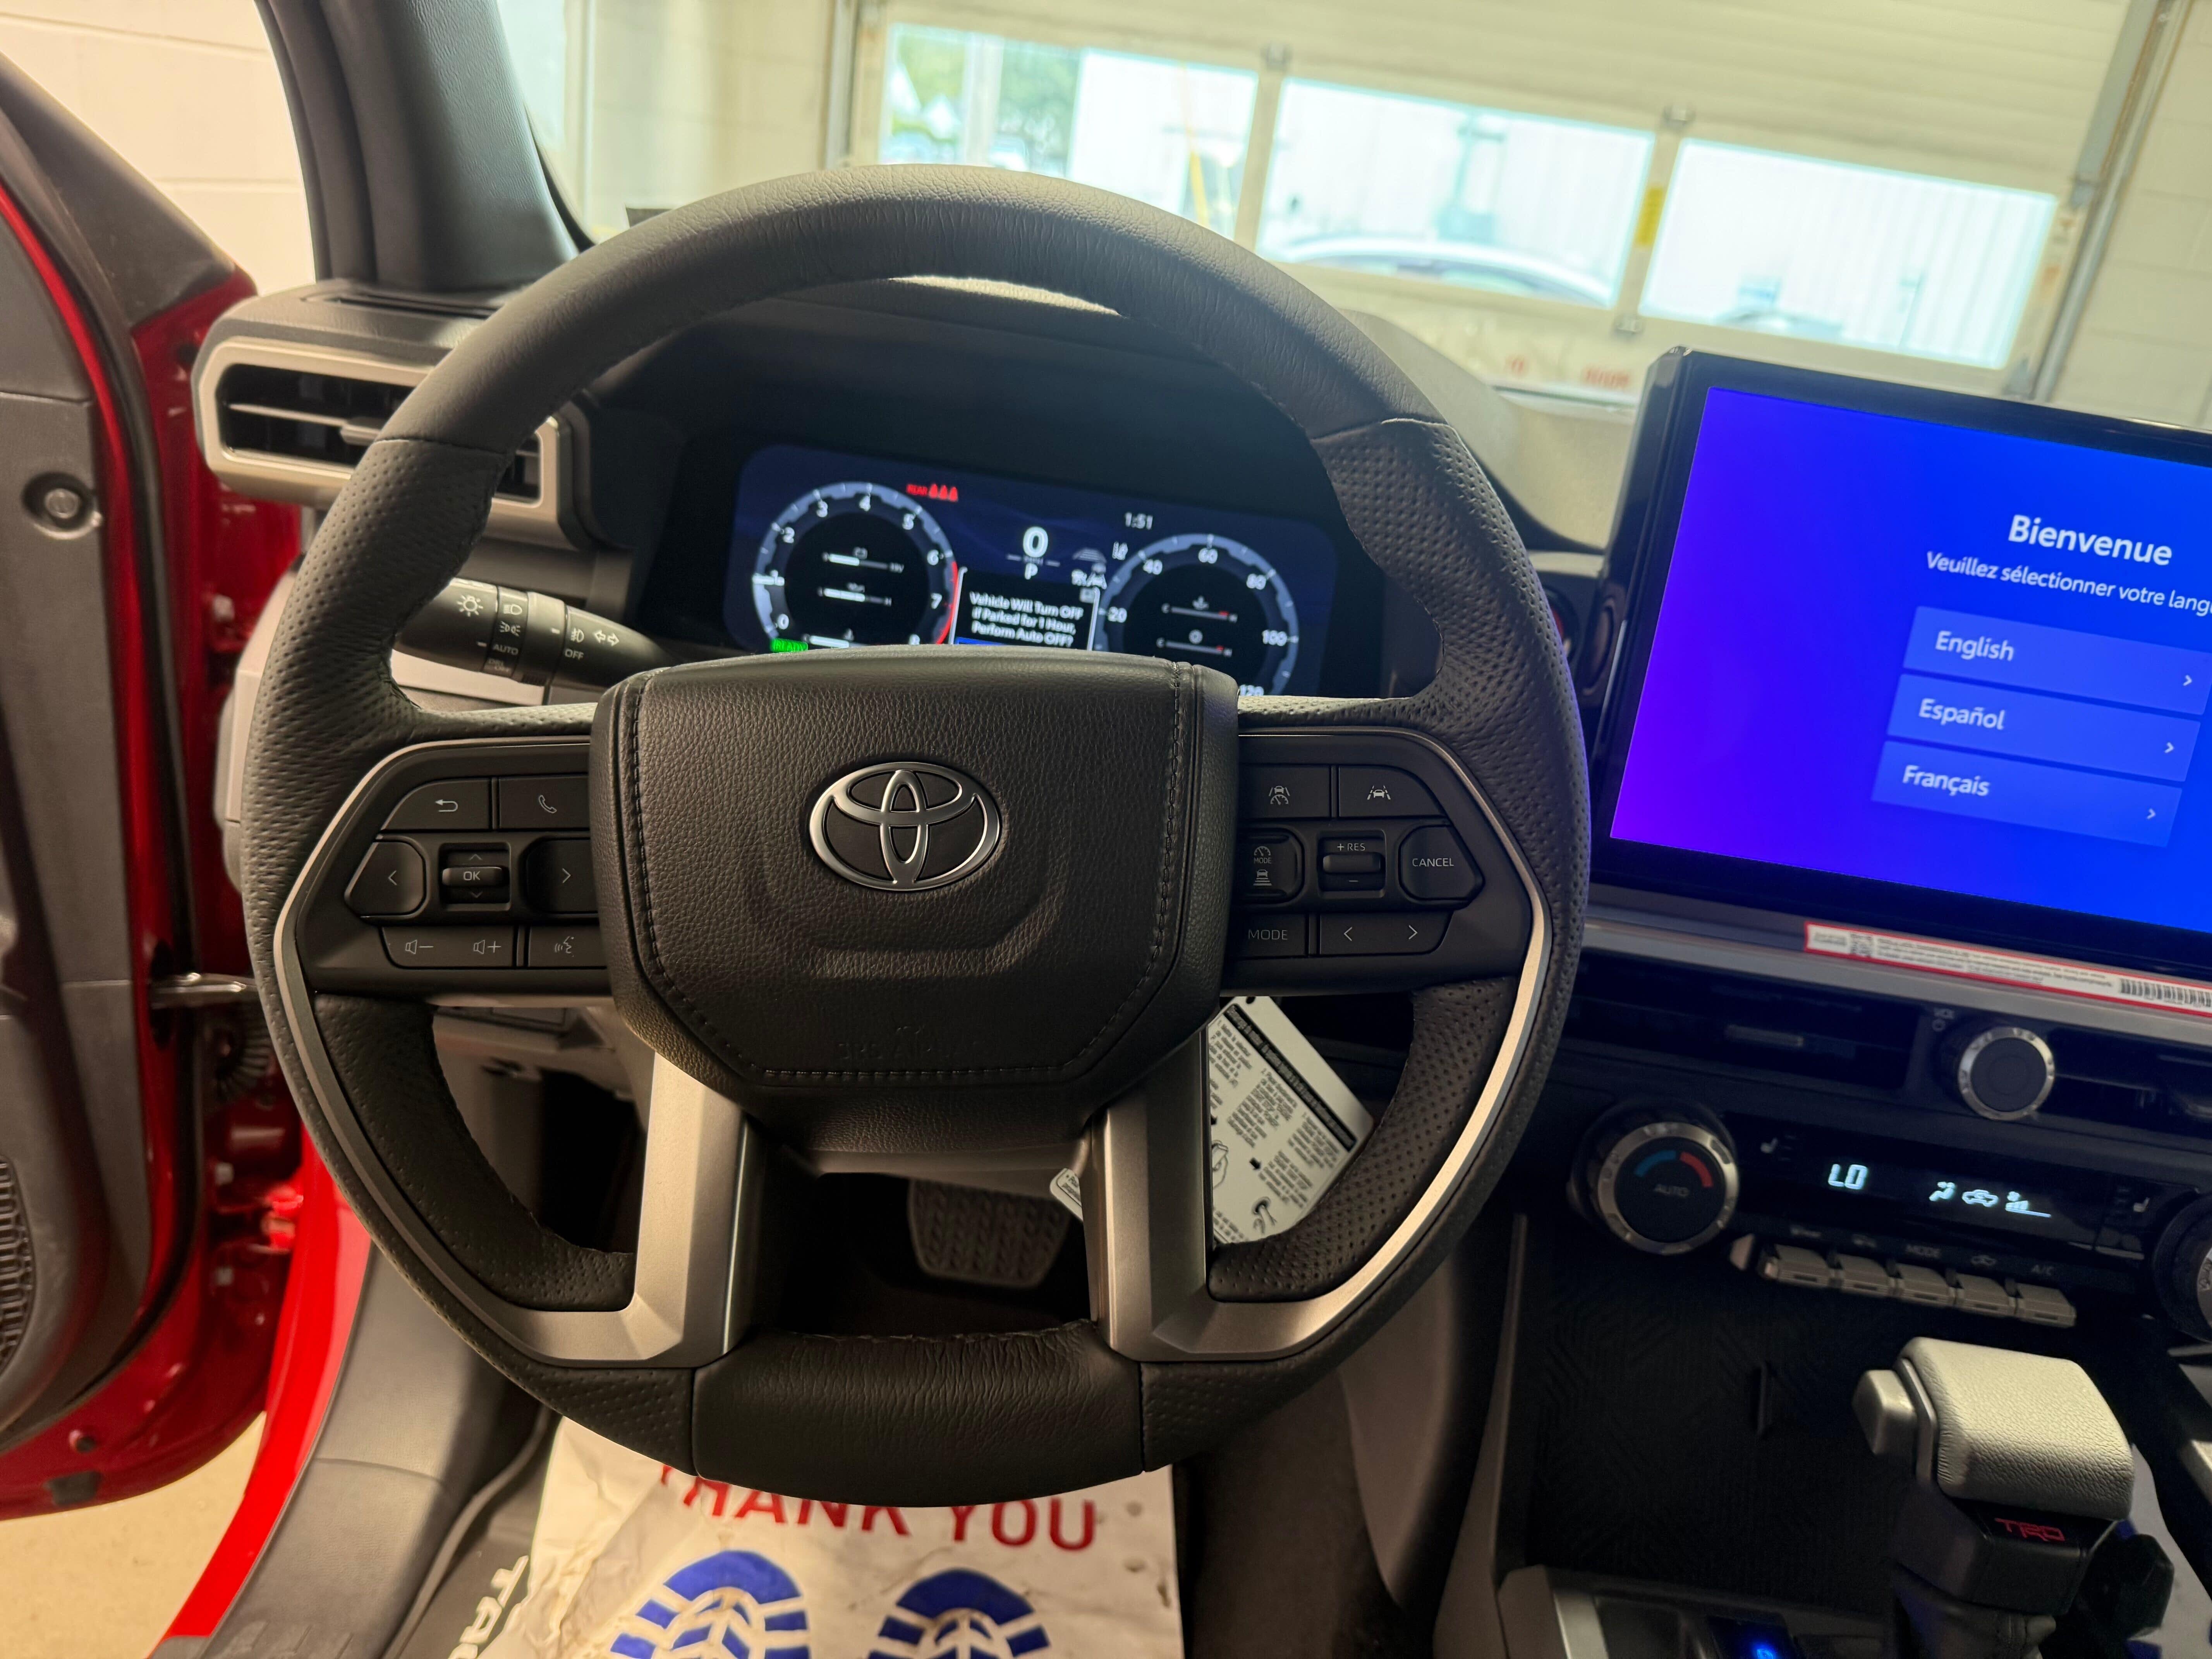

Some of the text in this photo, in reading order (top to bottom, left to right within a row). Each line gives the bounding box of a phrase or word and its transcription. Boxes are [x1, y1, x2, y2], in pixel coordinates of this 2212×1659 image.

[817, 501, 828, 517] 3
[859, 496, 871, 511] 4
[902, 514, 915, 530] 5
[1125, 512, 1153, 530] 1:51
[783, 527, 795, 543] 2
[1023, 526, 1048, 557] 0
[2008, 514, 2172, 566] Bienvenue
[927, 550, 939, 565] 6
[1198, 548, 1218, 564] 60
[1025, 563, 1038, 579] P
[1143, 559, 1163, 575] 40
[1247, 574, 1266, 590] 80
[1927, 551, 1998, 579] Veuillez
[2000, 565, 2116, 598] sélectionner
[2119, 587, 2165, 606] votre
[931, 593, 942, 609] 7
[969, 591, 1010, 609] Vehicle
[1010, 598, 1033, 613] Will
[1034, 601, 1059, 617] Turn
[777, 613, 789, 630] 0
[972, 606, 982, 620] If
[981, 608, 1020, 625] Parked
[1020, 613, 1037, 628] for
[1108, 606, 1127, 623] 20
[971, 620, 1015, 639] Perform
[1015, 628, 1043, 643] Auto
[1262, 629, 1287, 646] 100
[493, 644, 519, 655] AUTO
[1936, 630, 2014, 661] English
[565, 648, 584, 660] OFF
[1918, 698, 2005, 730] Español
[1902, 764, 1990, 796] Français
[1347, 843, 1365, 851] RES
[1412, 857, 1454, 867] CANCEL
[463, 871, 481, 881] OK
[1248, 929, 1288, 941] MODE
[950, 1497, 1096, 1551] YOU
[1995, 1517, 2066, 1542] TRD
